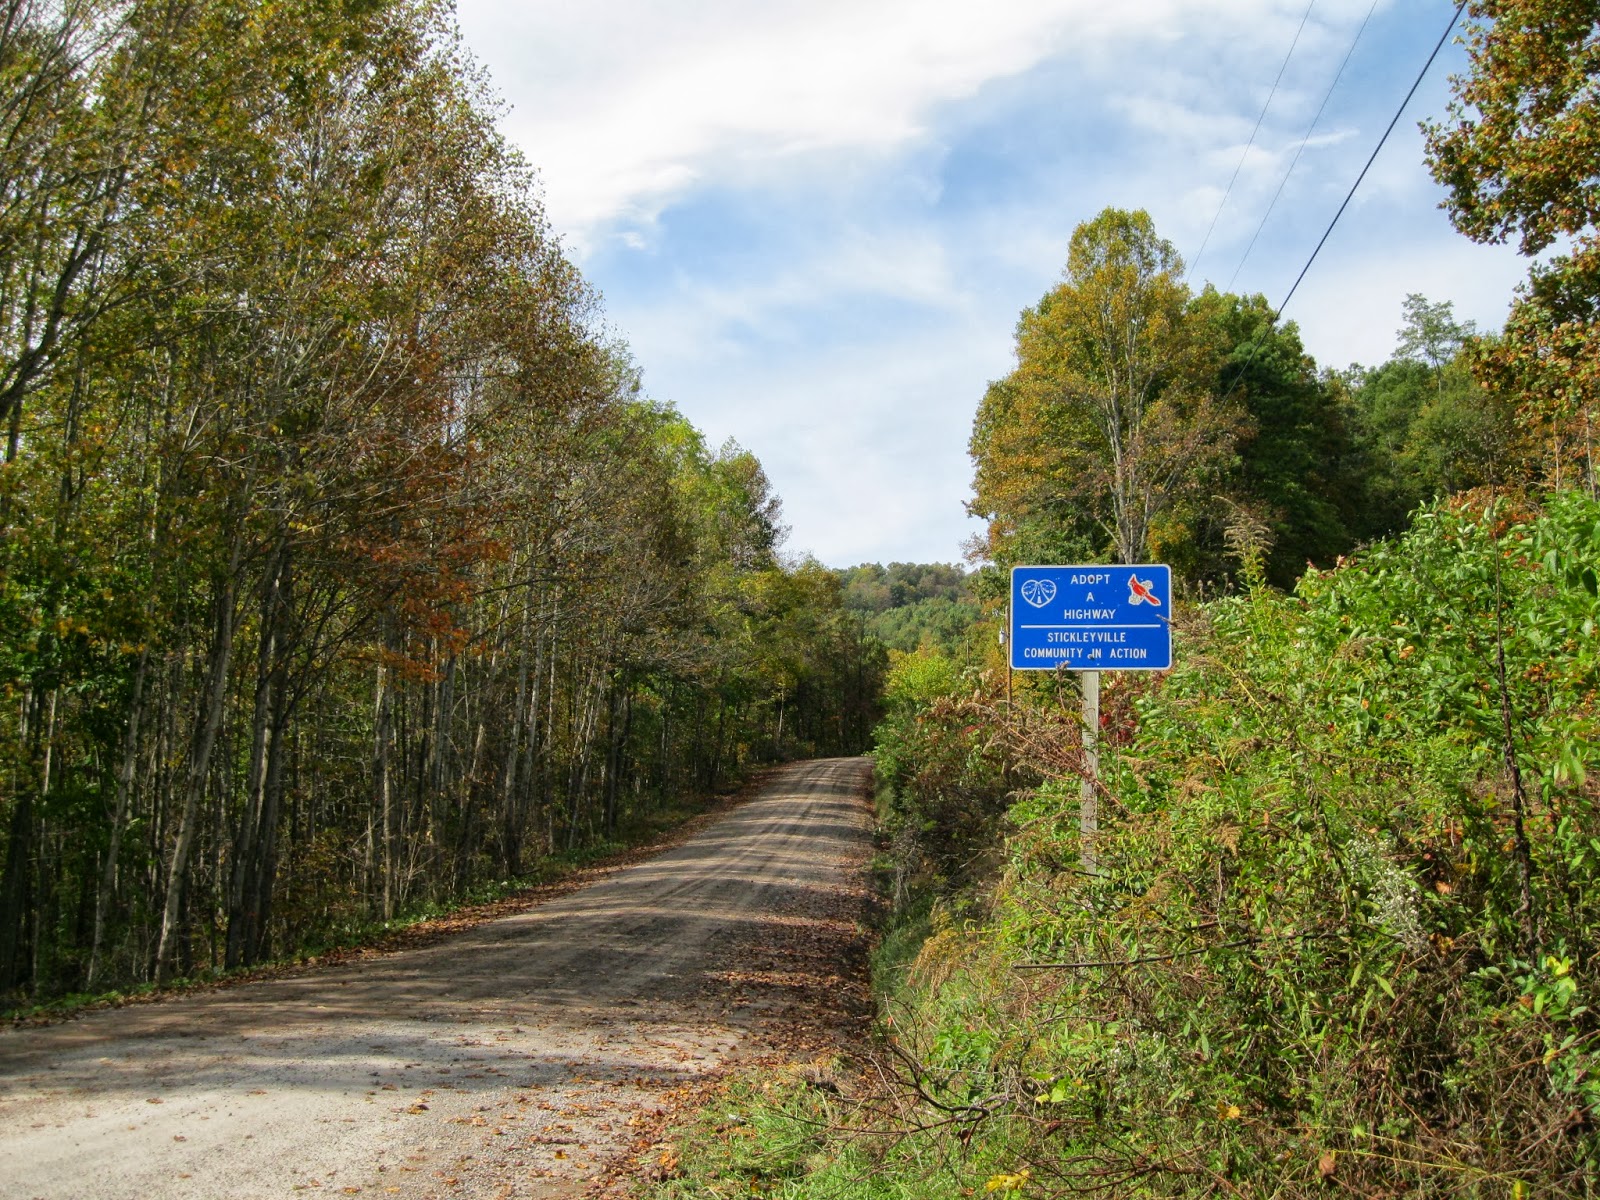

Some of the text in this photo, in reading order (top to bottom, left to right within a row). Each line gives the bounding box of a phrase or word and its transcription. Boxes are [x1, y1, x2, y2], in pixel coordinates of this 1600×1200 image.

[1070, 574, 1111, 585] ADOPT
[1086, 592, 1095, 602] A
[1064, 609, 1116, 619] HIGHWAY
[1047, 632, 1126, 642] STICKLEYVILLE
[1024, 648, 1147, 658] COMMUNITY IN ACTION
